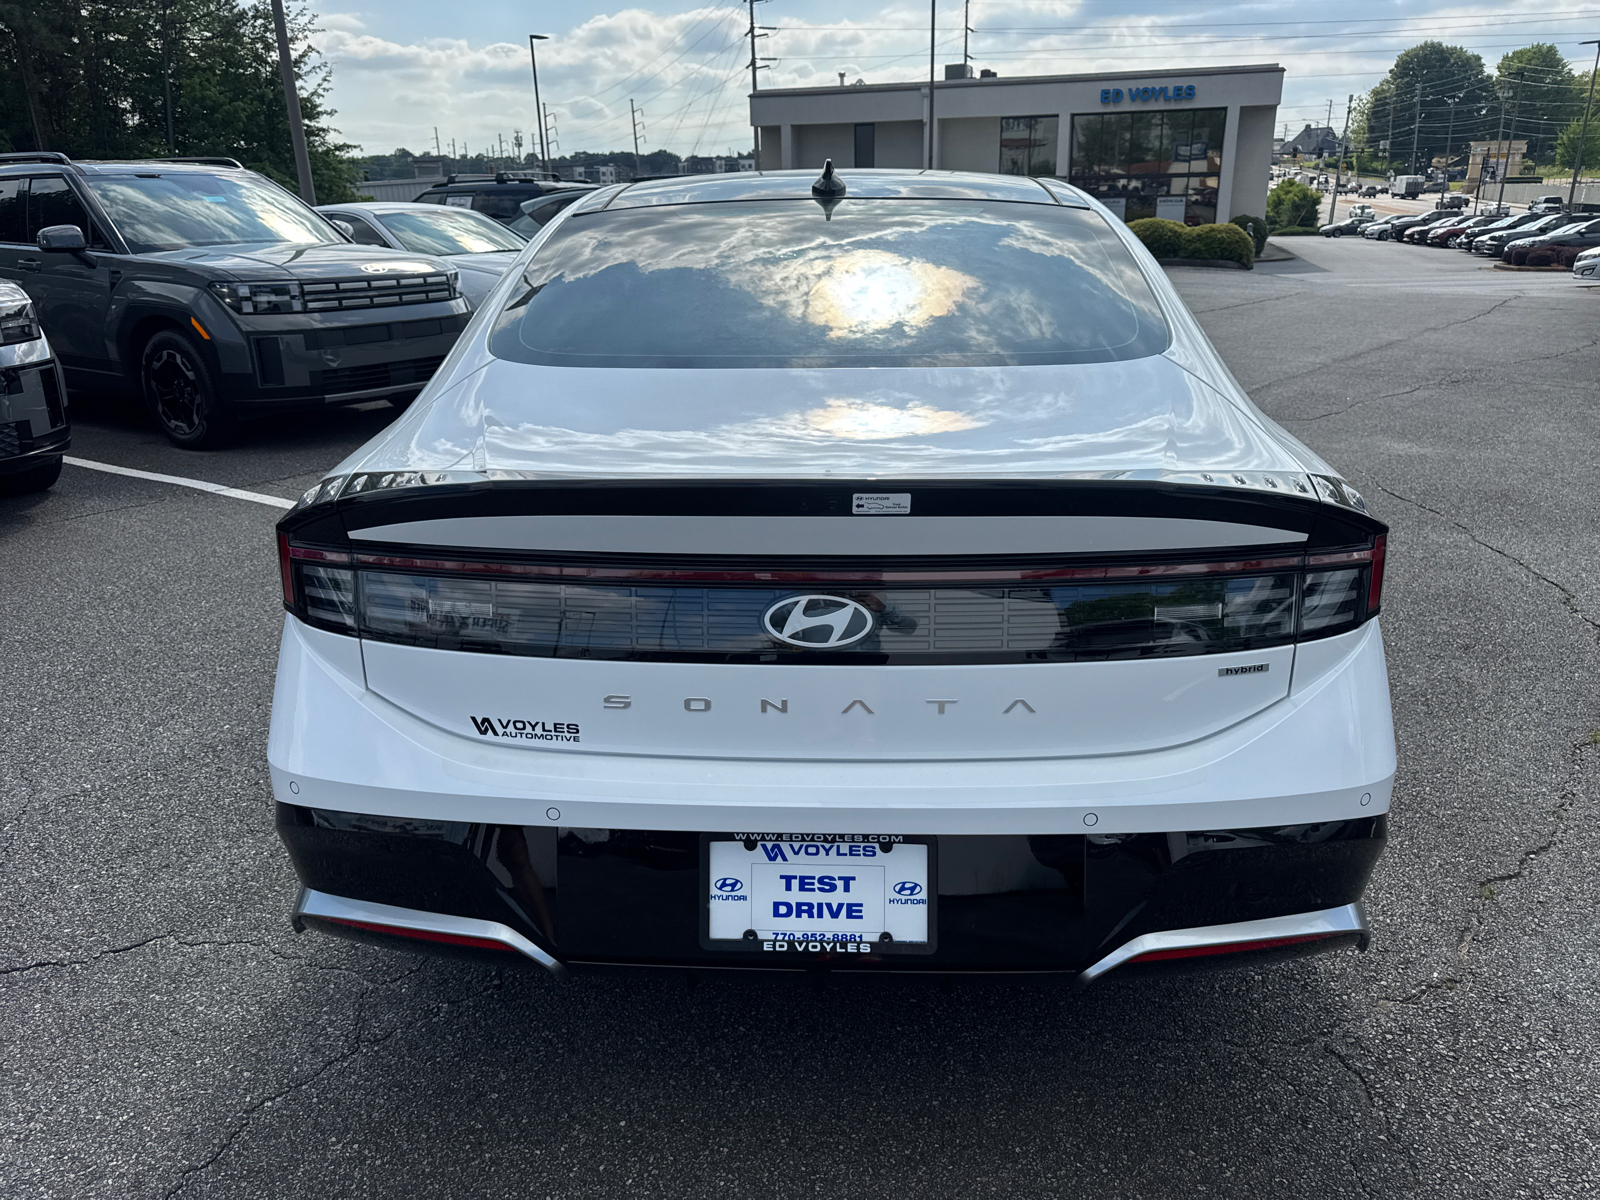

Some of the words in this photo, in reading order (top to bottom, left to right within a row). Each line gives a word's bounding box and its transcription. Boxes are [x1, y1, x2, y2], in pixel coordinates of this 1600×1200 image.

[1100, 88, 1124, 103] ED
[1128, 84, 1196, 102] VOYLES
[1226, 664, 1264, 675] hybrid
[603, 694, 1037, 714] SONATA
[497, 718, 580, 735] VOYLES
[501, 731, 580, 742] AUTOMOTIVE
[734, 833, 903, 843] WWW.EDVOYLES.COM
[789, 844, 877, 857] VOYLES
[779, 874, 856, 893] TEST
[710, 894, 747, 902] HYUNDAI
[772, 901, 864, 920] DRIVE
[772, 932, 863, 942] 770-952-8881
[763, 942, 788, 952] ED
[795, 943, 872, 953] VOYLES
